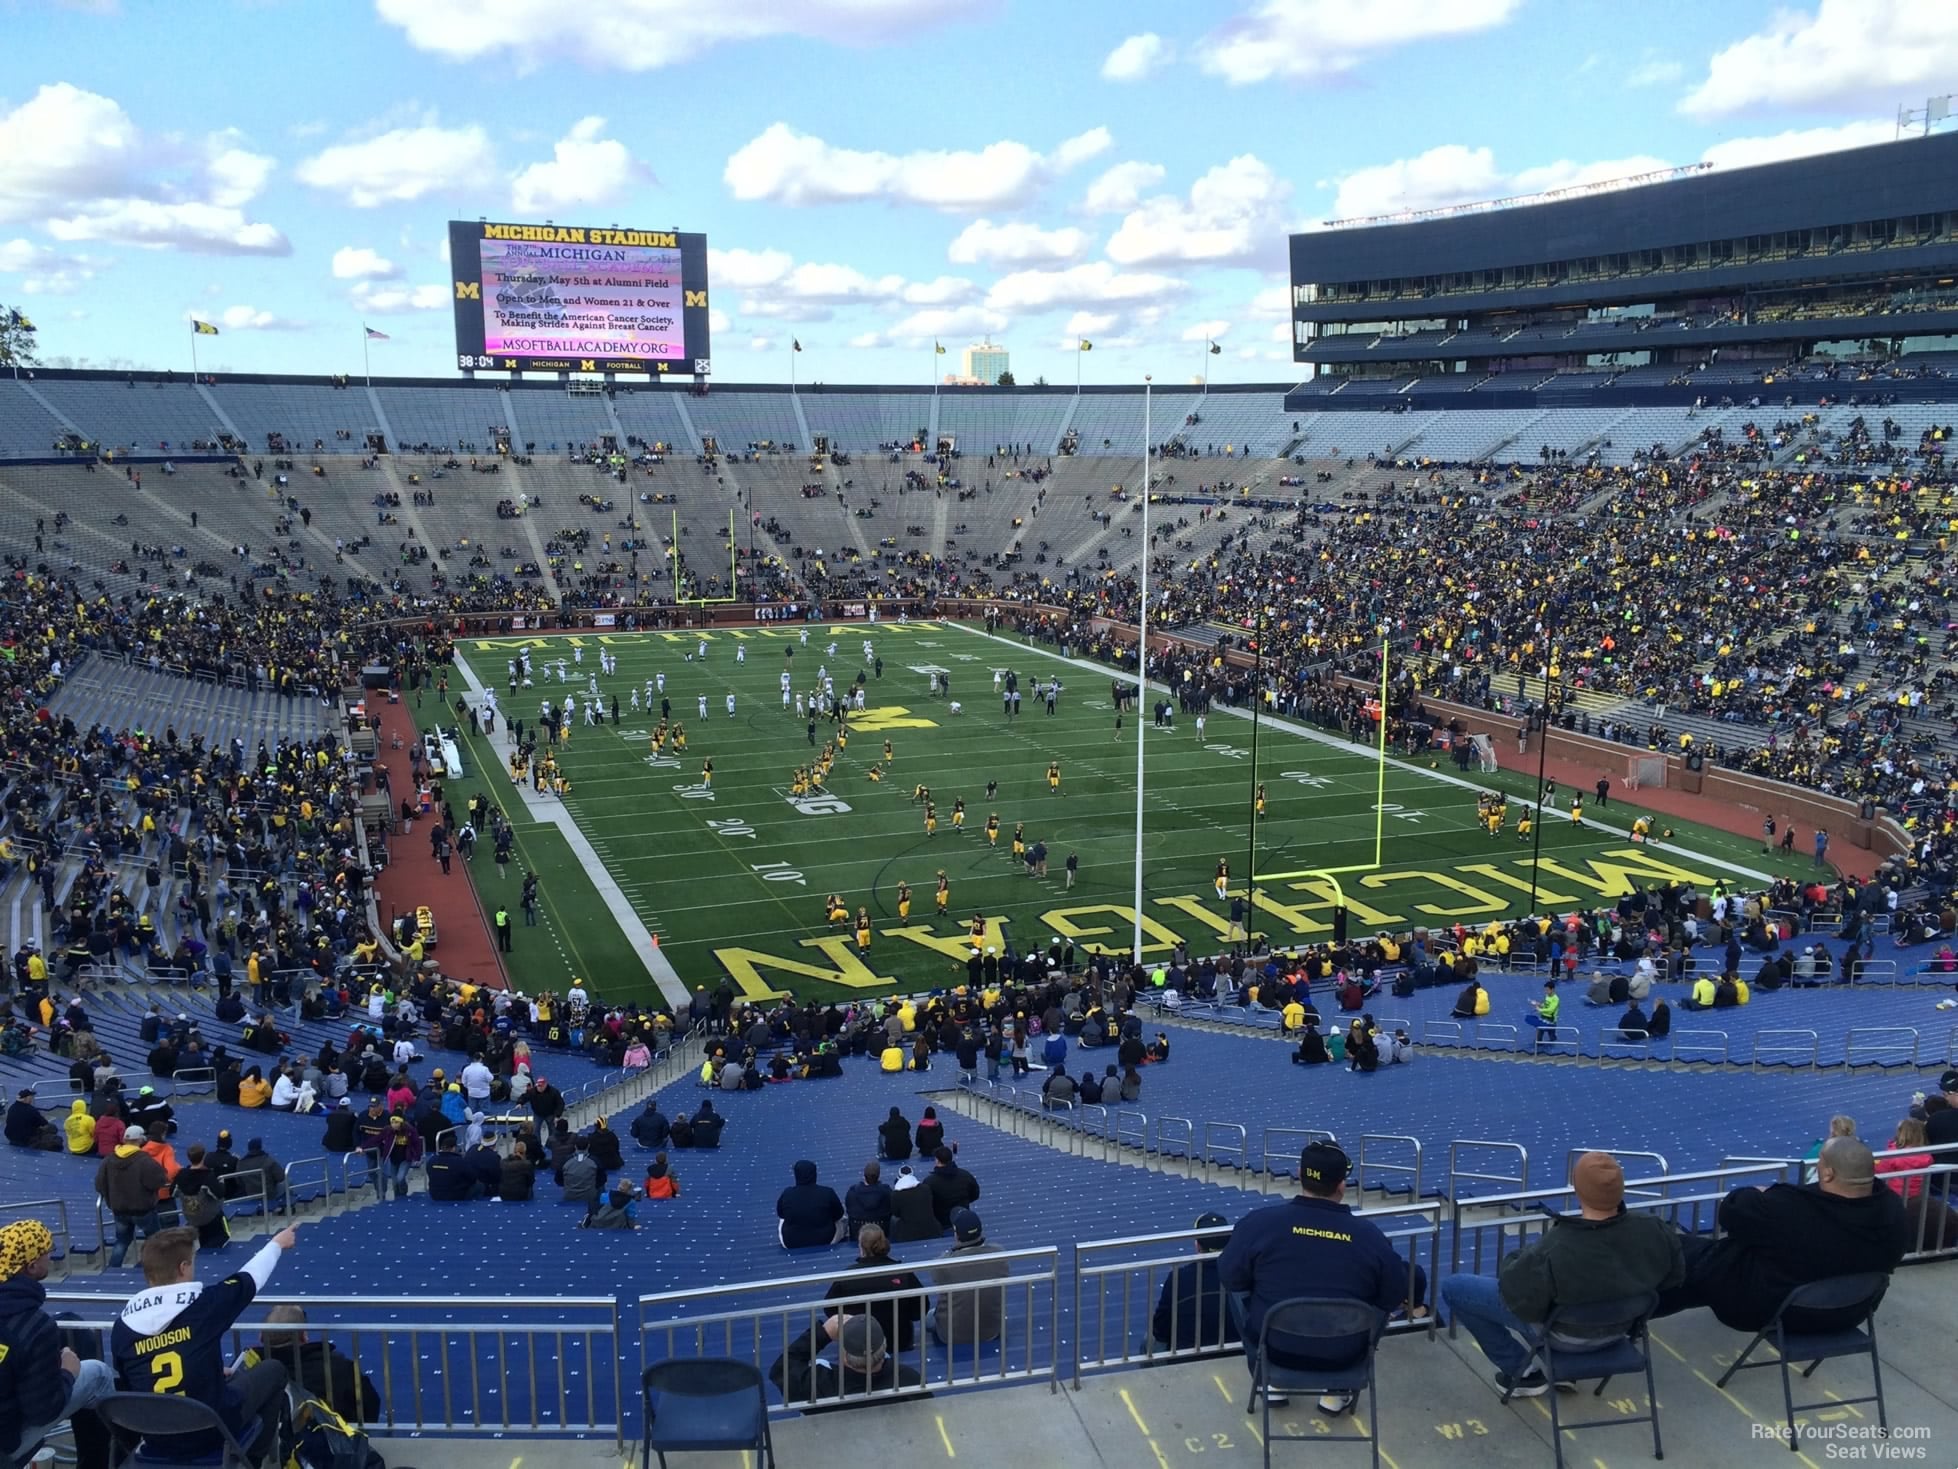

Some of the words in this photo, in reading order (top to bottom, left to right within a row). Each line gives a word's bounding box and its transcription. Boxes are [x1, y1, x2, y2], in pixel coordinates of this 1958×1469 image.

[484, 224, 585, 243] MICHIGAN
[590, 230, 677, 247] STADIUM
[540, 247, 625, 261] MICHIGAN
[495, 273, 546, 285] Thursday,
[550, 276, 572, 286] May
[574, 276, 590, 286] 5th
[593, 278, 601, 286] at
[605, 277, 642, 288] Alumni
[645, 278, 669, 289] Field
[456, 281, 479, 299] M
[496, 293, 524, 305] Open
[526, 296, 537, 304] to
[539, 295, 561, 304] Men
[563, 295, 581, 305] and
[584, 296, 620, 306] Women
[623, 298, 633, 306] 21
[636, 298, 645, 307] &
[647, 299, 670, 308] Over
[685, 290, 707, 307] M
[494, 310, 506, 319] To
[508, 310, 542, 320] Benefit
[544, 312, 559, 321] the
[561, 313, 604, 322] American
[607, 314, 638, 323] Cancer
[640, 314, 674, 325] Society,
[501, 319, 536, 329] Making
[538, 319, 569, 329] Strides
[572, 321, 606, 331] Against
[608, 322, 635, 331] Breast
[637, 322, 668, 331] Cancer
[502, 339, 668, 354] MSOFTBALLACADEMY.ORG
[459, 354, 494, 368] 38:04
[505, 359, 517, 368] M
[581, 360, 595, 370] M
[606, 362, 642, 370] FOOTBALL
[657, 362, 668, 371] M
[472, 622, 946, 651] MICHIGAN
[1279, 771, 1334, 786] 20
[672, 783, 716, 799] 30
[705, 818, 756, 836] 20
[751, 861, 804, 882] 10
[713, 848, 1736, 1002] MICHIGAN
[1292, 1226, 1352, 1241] MICHIGAN
[134, 1326, 192, 1356] WOODSON
[151, 1351, 186, 1396] 2
